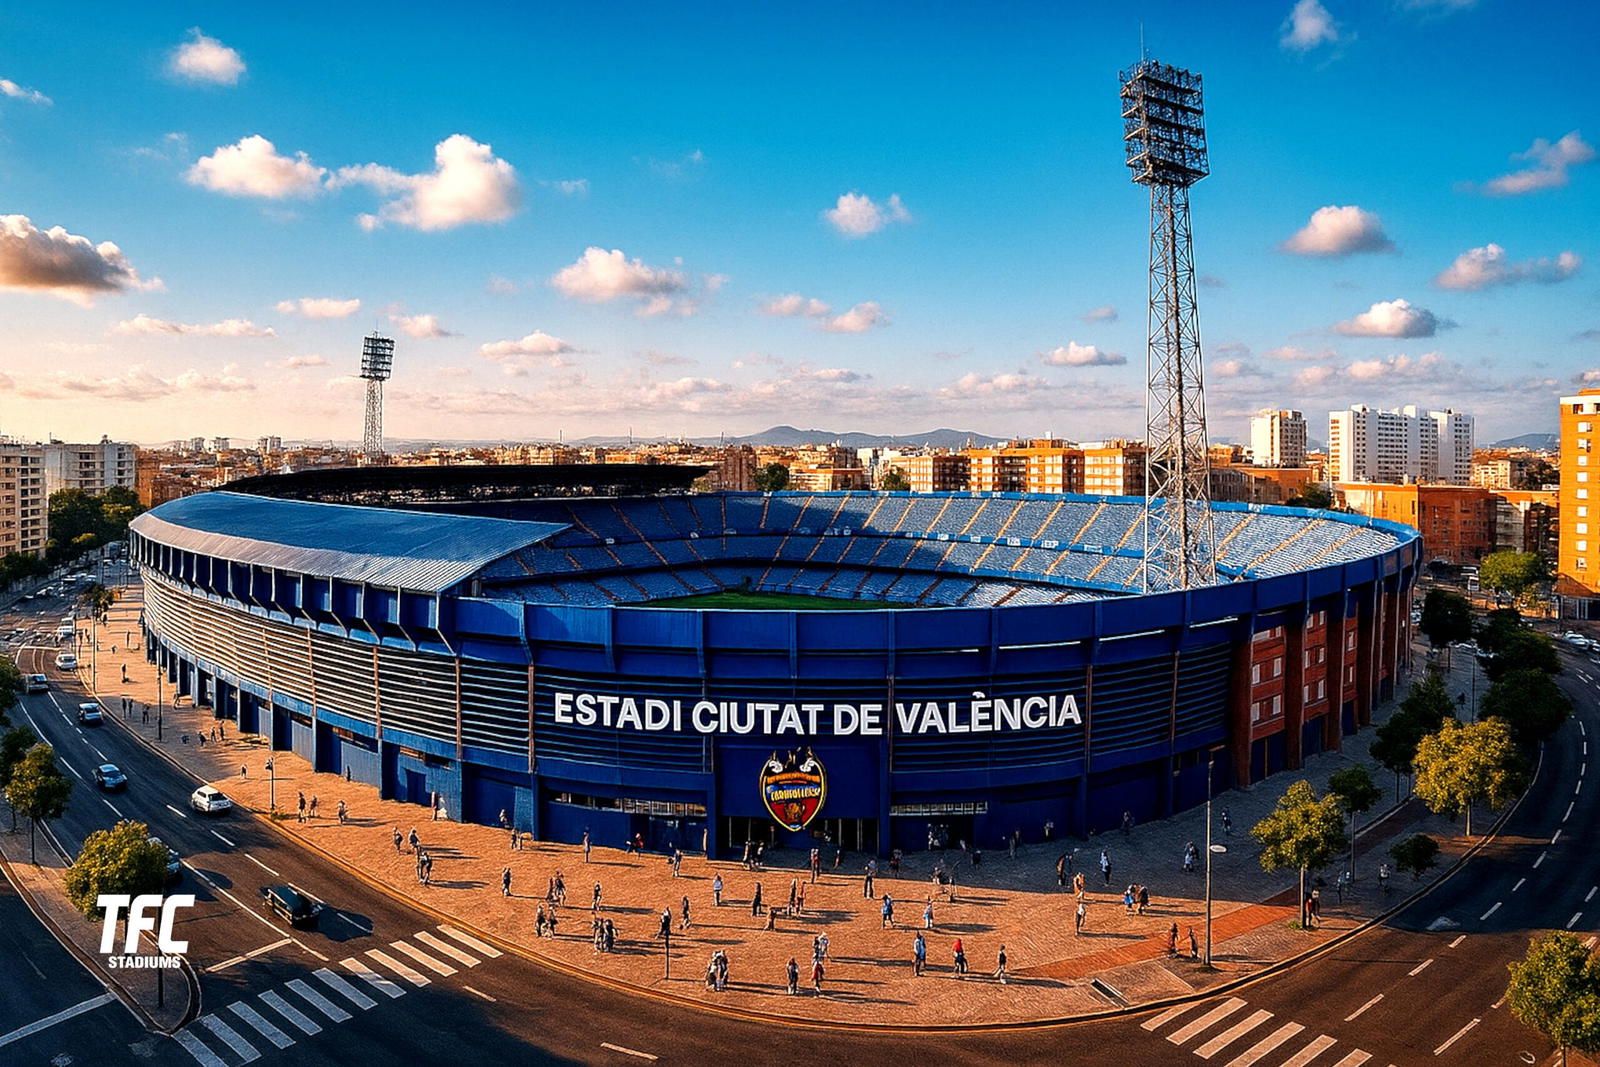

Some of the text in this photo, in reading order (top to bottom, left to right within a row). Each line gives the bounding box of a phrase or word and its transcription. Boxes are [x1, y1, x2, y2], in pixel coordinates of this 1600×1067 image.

[554, 692, 1082, 735] ESTADI CIUTAT DE VALÈNCIA
